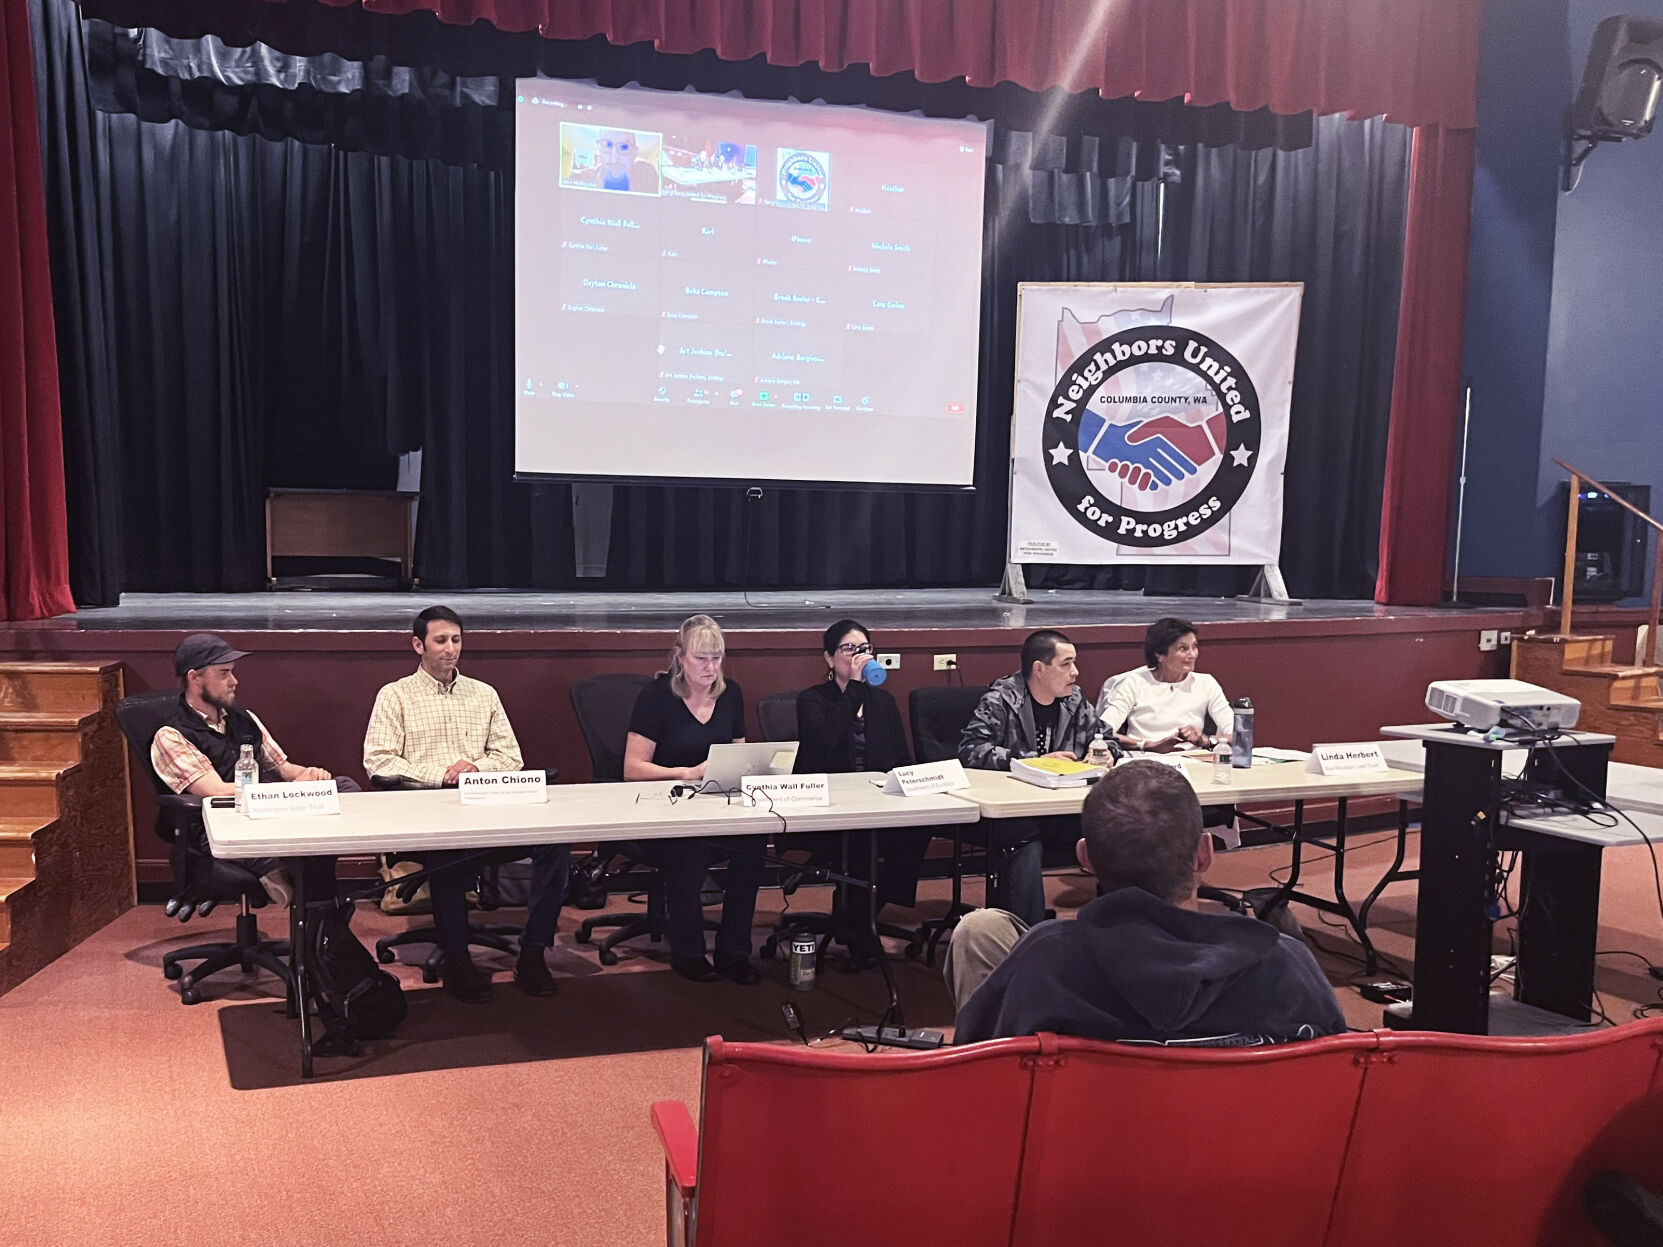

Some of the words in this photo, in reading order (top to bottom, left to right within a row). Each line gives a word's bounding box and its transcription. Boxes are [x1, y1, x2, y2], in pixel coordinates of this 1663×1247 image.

[1052, 338, 1176, 423] Neighbors
[1183, 340, 1250, 424] United
[1100, 396, 1148, 405] COLUMBIA
[1151, 396, 1191, 406] COUNTY,
[1193, 396, 1208, 404] WA
[1077, 495, 1113, 528] for
[1117, 496, 1221, 539] Progress
[1346, 751, 1379, 760] Herbert
[464, 777, 498, 785] Anton
[501, 776, 541, 784] Chiono
[901, 775, 944, 785] Peterschmidt
[251, 792, 279, 800] Ethan
[283, 789, 333, 799] Lockwood
[793, 943, 814, 952] YETI
